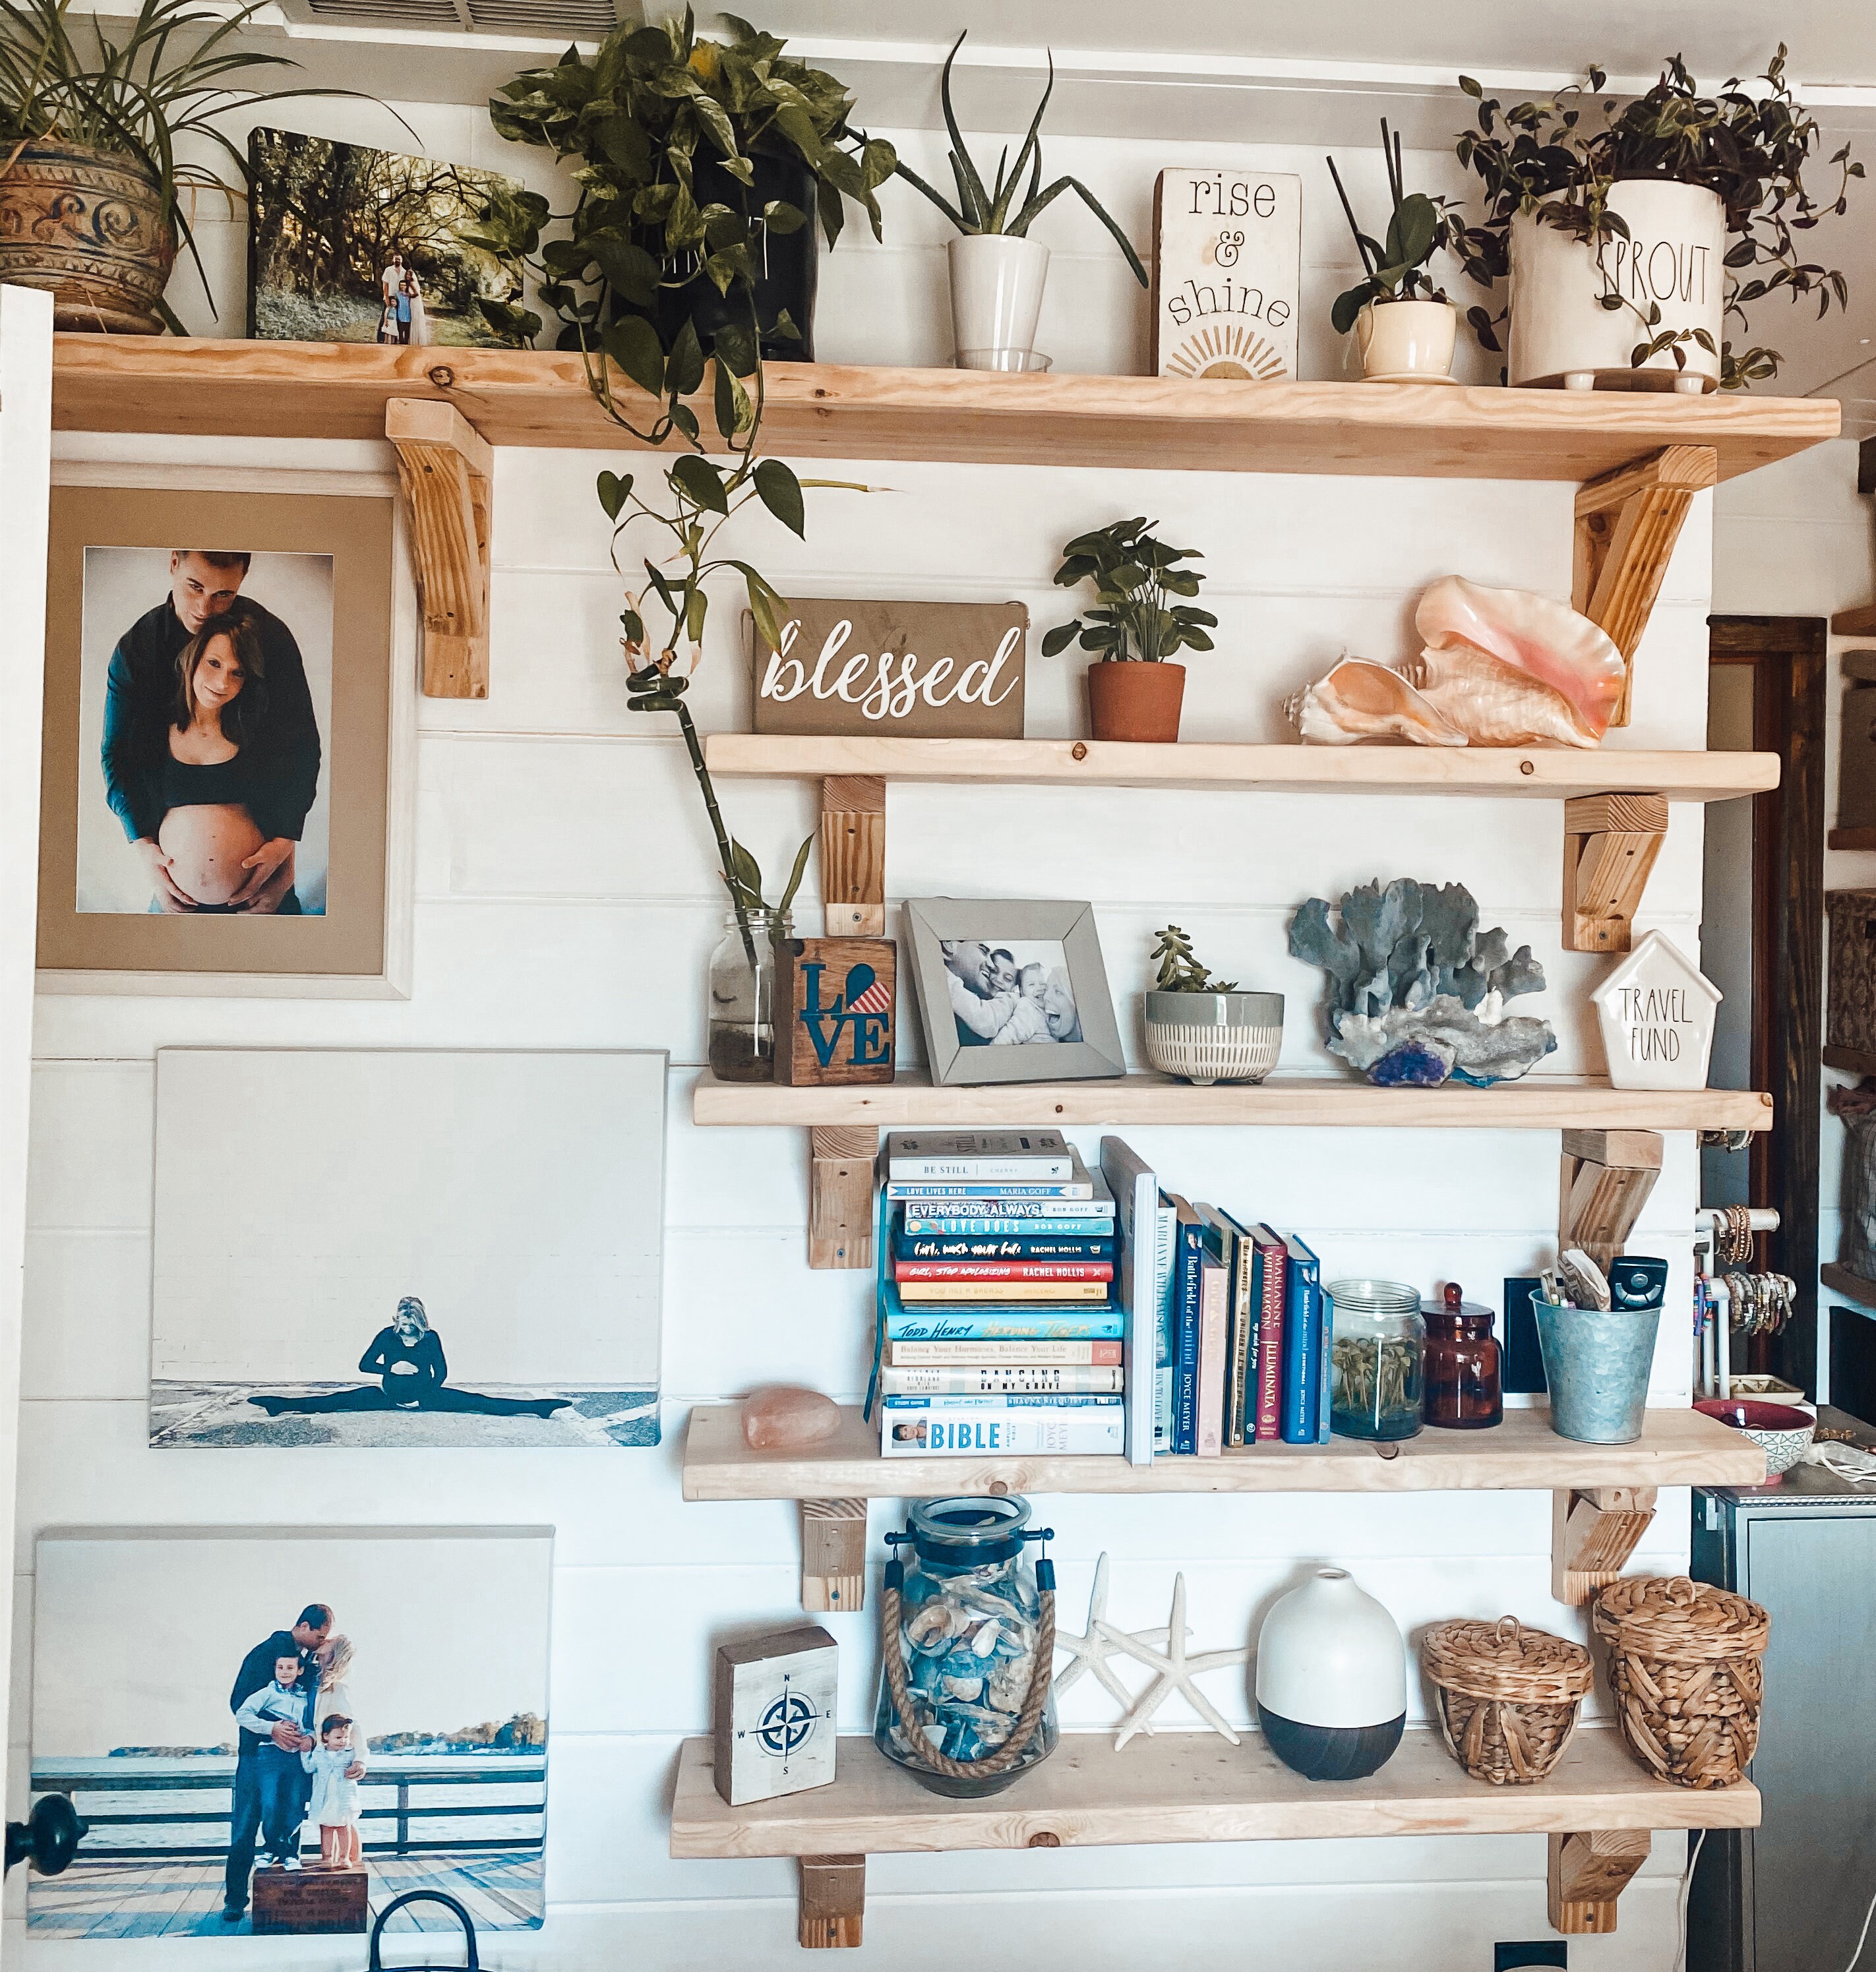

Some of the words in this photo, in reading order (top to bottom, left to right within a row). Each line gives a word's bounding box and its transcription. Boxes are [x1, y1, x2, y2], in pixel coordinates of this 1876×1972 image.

[1188, 173, 1275, 218] rise
[1215, 230, 1245, 267] &
[1594, 241, 1710, 305] SPROUT
[1168, 278, 1290, 326] shine
[760, 618, 1021, 720] blessed
[1618, 988, 1693, 1023] TRAVEL
[1632, 1027, 1680, 1061] FUND
[924, 1166, 936, 1174] BE
[940, 1166, 969, 1174] STILL
[941, 1220, 976, 1232] LOVE
[984, 1220, 1019, 1232] DOES
[1030, 1245, 1056, 1254] RACHEL
[1058, 1245, 1082, 1254] HOLLIS
[1157, 1215, 1168, 1270] MARIANNE
[935, 1266, 959, 1276] STOP
[1023, 1267, 1054, 1277] RACHEL
[1056, 1267, 1085, 1277] HOLLIS
[1186, 1255, 1198, 1304] Battlefield
[1261, 1251, 1274, 1330] WILLIAMSON
[1273, 1254, 1284, 1328] MARIANNE
[1185, 1305, 1194, 1314] of
[899, 1322, 928, 1338] TODD
[929, 1319, 974, 1339] HENRY
[1252, 1323, 1259, 1332] my
[901, 1345, 930, 1354] Balance
[1183, 1330, 1195, 1365] mind
[1250, 1347, 1259, 1358] for
[1183, 1373, 1192, 1400] JOYCE
[1260, 1340, 1279, 1409] ILLUMINATA
[1182, 1402, 1192, 1431] MEYER
[930, 1423, 1000, 1449] BIBLE
[1046, 1417, 1056, 1449] JOYC
[1058, 1414, 1068, 1450] MEY
[826, 1710, 831, 1719] E
[783, 1766, 789, 1775] S
